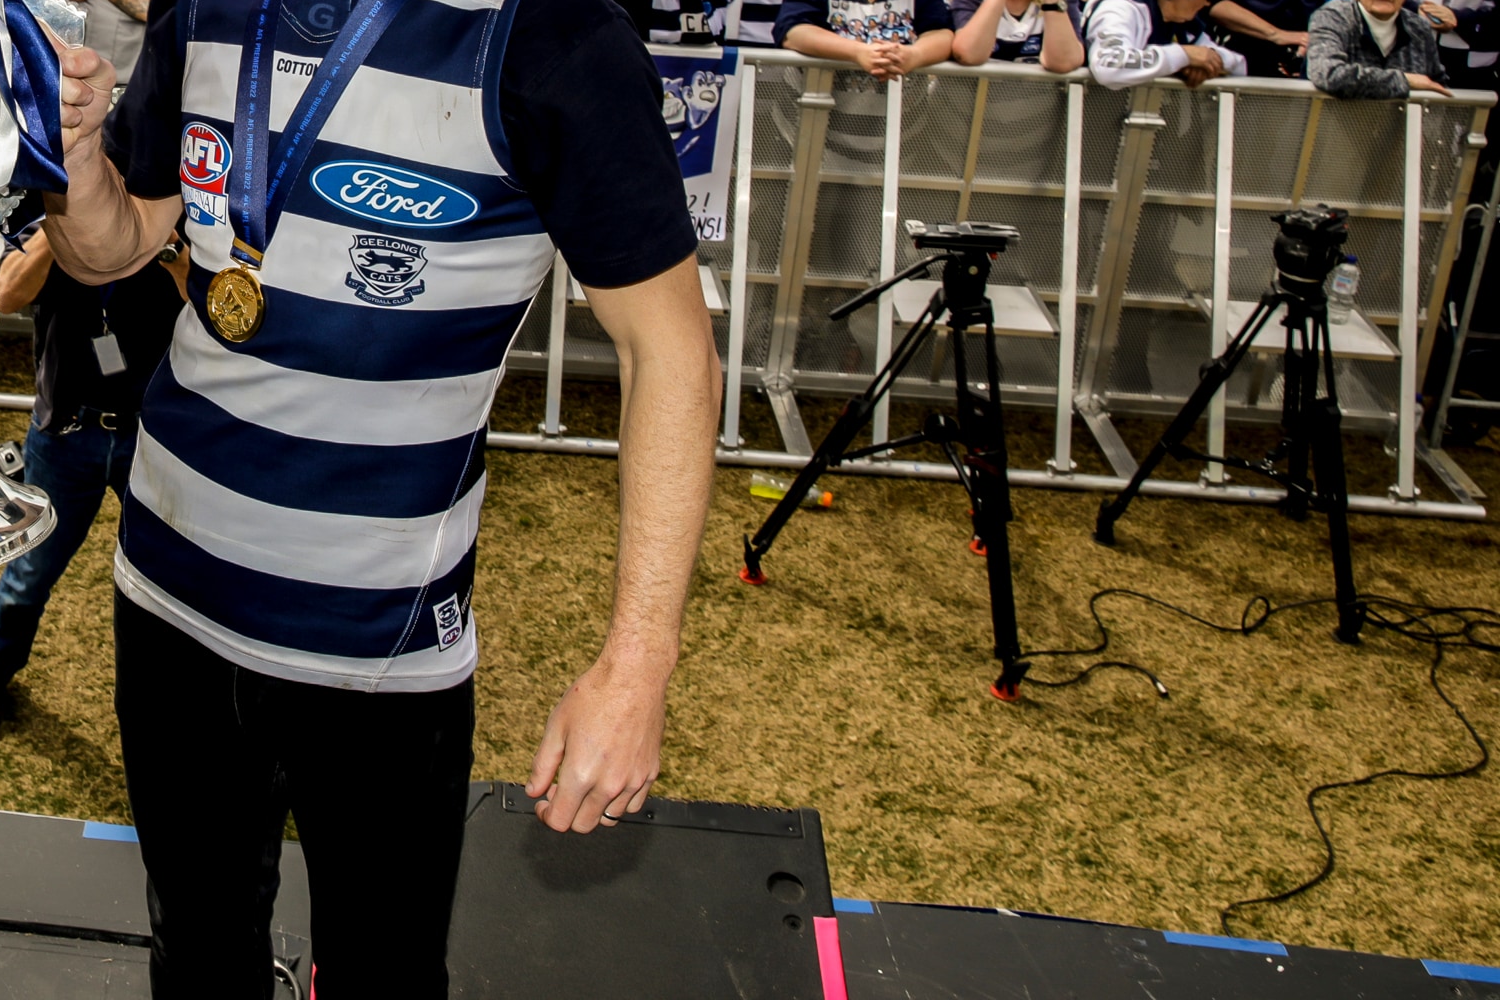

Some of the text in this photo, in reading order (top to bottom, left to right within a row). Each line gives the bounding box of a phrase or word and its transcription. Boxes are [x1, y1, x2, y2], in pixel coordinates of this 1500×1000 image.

[307, 3, 335, 30] G
[338, 48, 351, 64] AFL
[347, 17, 372, 52] PREMIERS
[368, 0, 384, 18] 2022
[251, 42, 261, 79] PREMIERS
[250, 80, 258, 98] 2022
[293, 132, 302, 145] AFL
[299, 97, 322, 131] PREMIERS
[319, 79, 332, 97] 2022
[247, 118, 255, 130] AFL
[183, 134, 223, 172] AFL
[245, 133, 254, 170] PREMIERS
[243, 171, 252, 190] 2022
[276, 161, 287, 179] 2022
[193, 192, 225, 220] FINAL
[340, 169, 446, 221] Ford
[359, 238, 418, 254] GEELONG
[370, 272, 401, 282] CATS
[358, 291, 392, 304] FOOTBALL
[444, 629, 461, 642] AFL
